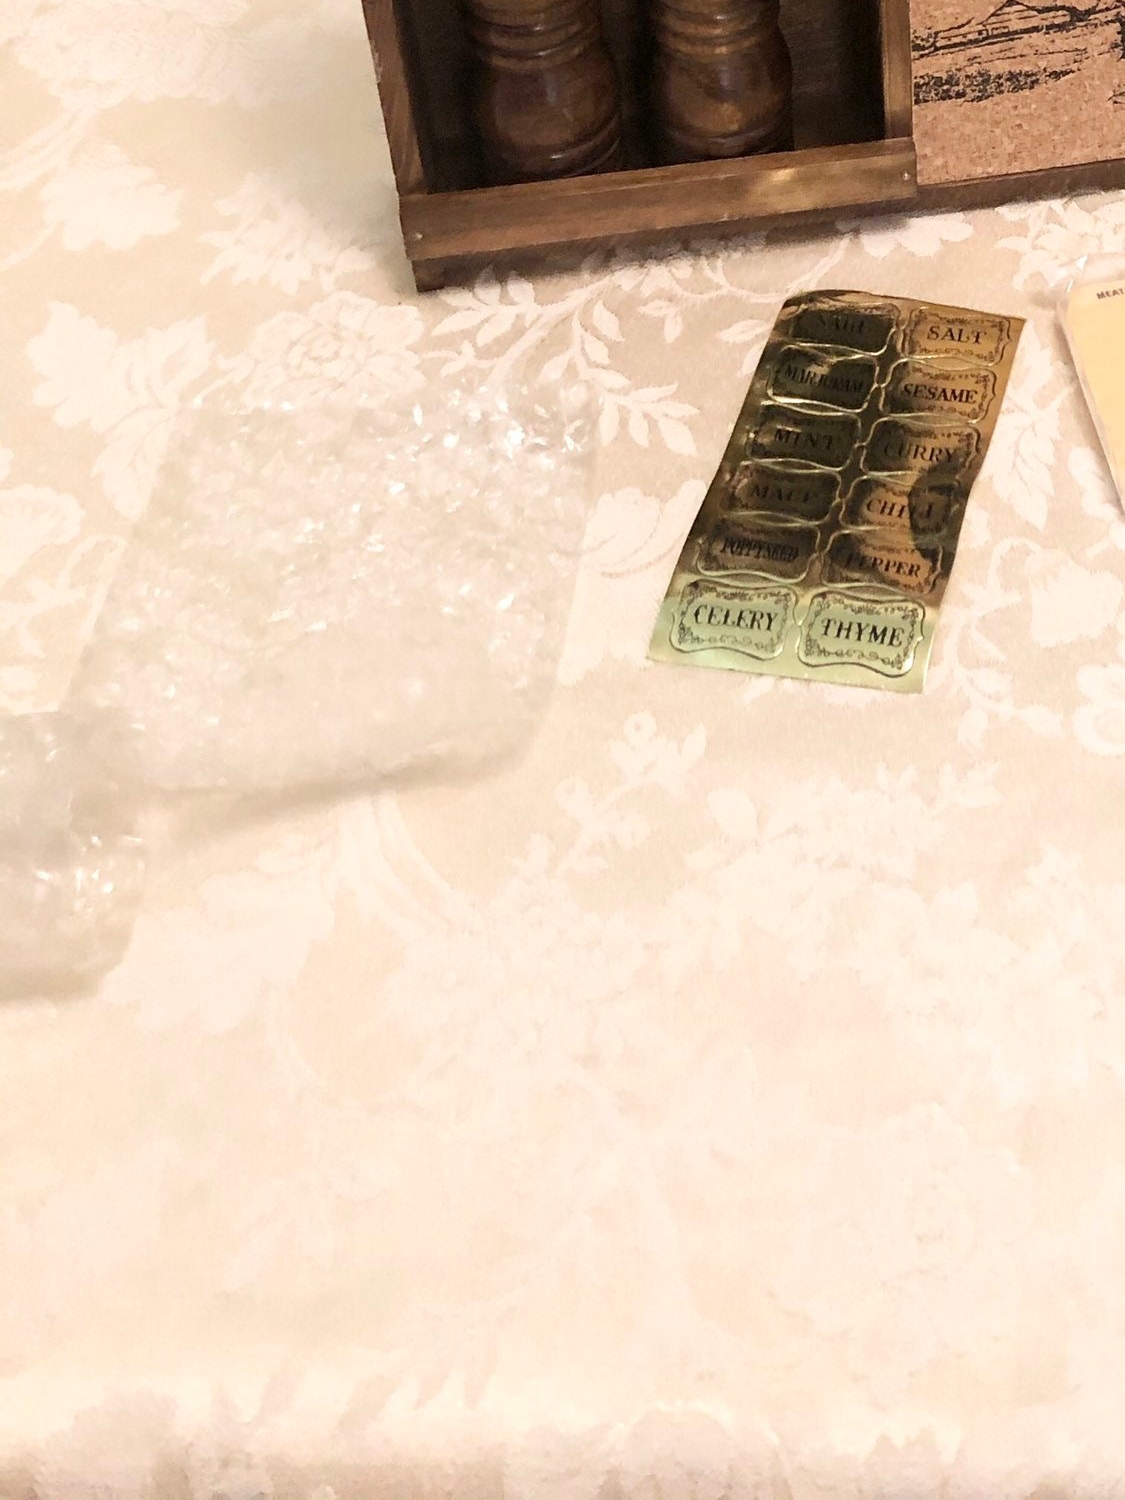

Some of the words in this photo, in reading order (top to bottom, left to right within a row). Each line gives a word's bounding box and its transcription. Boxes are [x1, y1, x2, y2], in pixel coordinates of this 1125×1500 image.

[926, 326, 987, 346] SALT
[902, 382, 978, 405] SESAME
[774, 428, 835, 451] MINT
[883, 441, 958, 464] CURRY
[844, 553, 922, 578] PEPPER
[693, 603, 777, 632] CELERY
[820, 618, 906, 647] THYME
